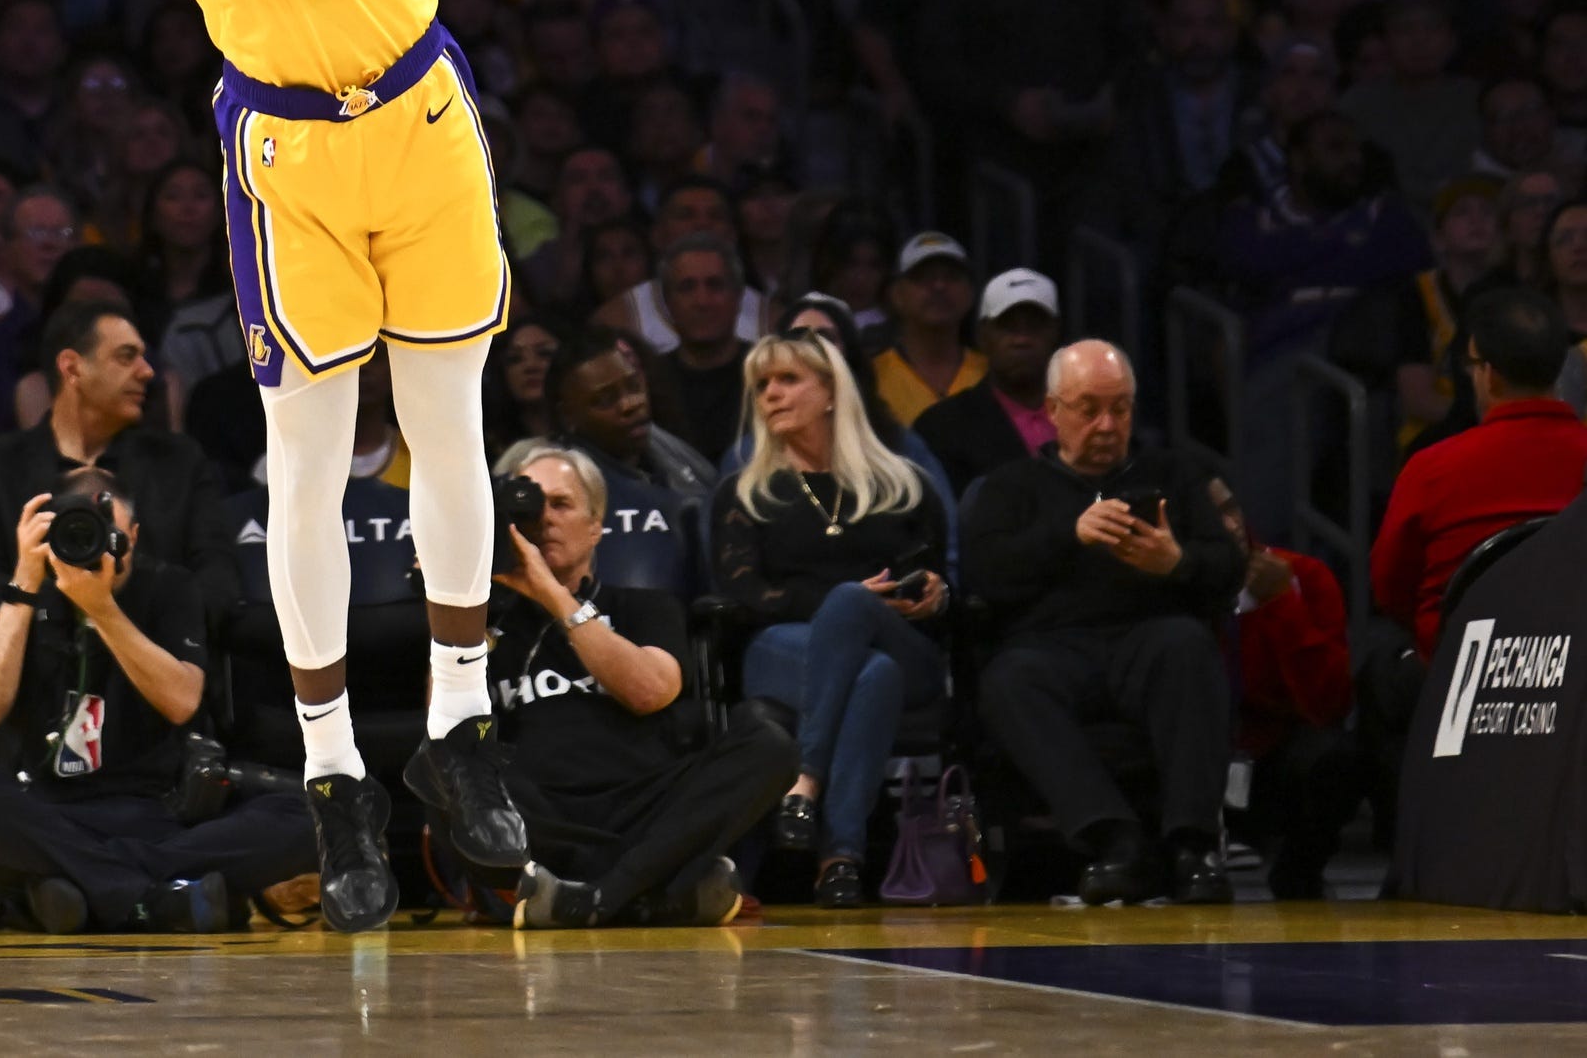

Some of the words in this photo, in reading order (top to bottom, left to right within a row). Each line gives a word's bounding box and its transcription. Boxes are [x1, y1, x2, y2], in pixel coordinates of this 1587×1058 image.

[346, 518, 412, 543] LTA
[1481, 635, 1571, 689] PECHANGA
[1470, 701, 1514, 734] RESORT
